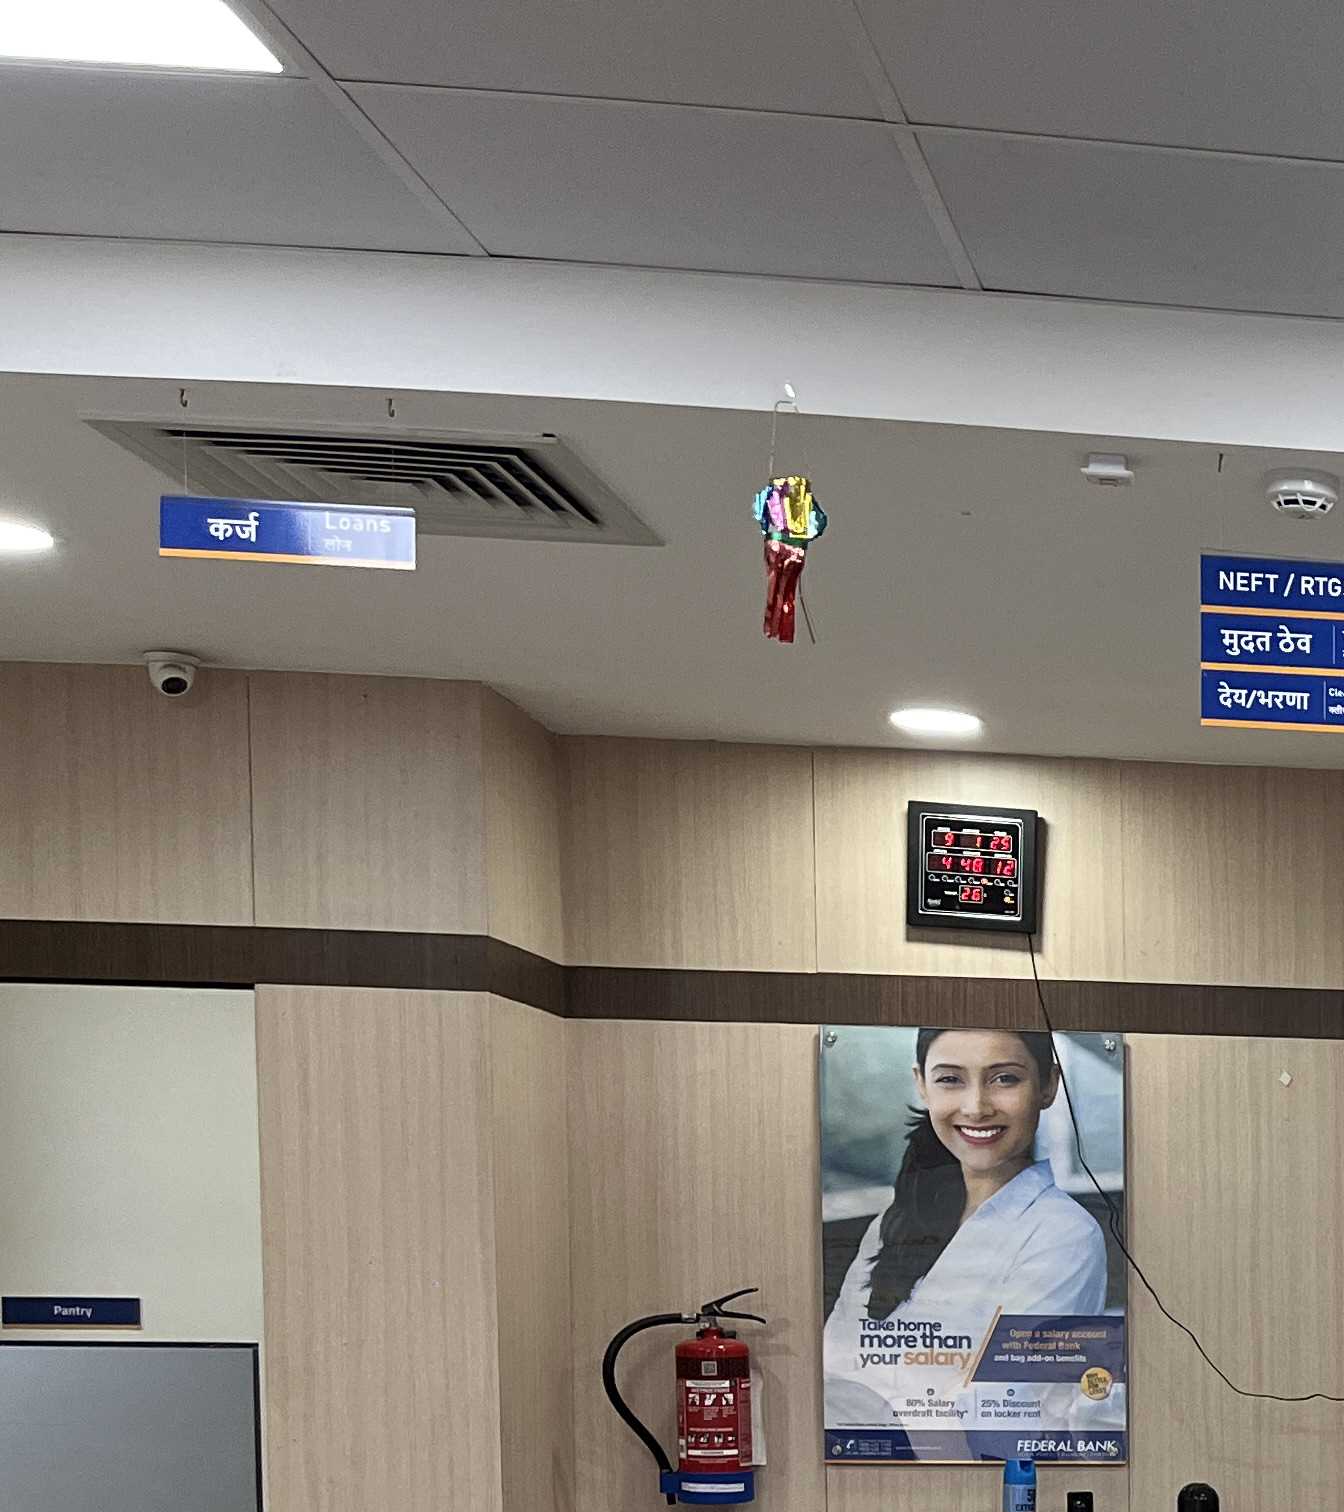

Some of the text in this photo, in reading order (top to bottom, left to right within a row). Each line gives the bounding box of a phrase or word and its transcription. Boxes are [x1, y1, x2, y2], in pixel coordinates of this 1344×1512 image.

[207, 511, 260, 542] कर्ज
[325, 511, 392, 533] Loans
[1218, 570, 1279, 593] NEFT
[1283, 573, 1295, 597] /
[1220, 625, 1312, 656] मुदत ठेव
[1217, 682, 1310, 711] देय/भरणा
[54, 1305, 93, 1318] Pantry
[859, 1318, 942, 1332] Take home
[860, 1328, 971, 1349] more than
[1009, 1328, 1033, 1339] Open
[1042, 1329, 1070, 1340] salary
[1071, 1329, 1107, 1338] account
[1002, 1341, 1080, 1350] with Federal Bank
[860, 1347, 971, 1369] your salary
[1026, 1354, 1055, 1362] add-on
[1056, 1354, 1087, 1363] benefits
[927, 1399, 956, 1409] Salary
[1002, 1399, 1041, 1408] Discount
[892, 1409, 933, 1418] overdraft
[980, 1409, 1041, 1418] on locker rent
[1016, 1439, 1117, 1453] FEDERAL BANK
